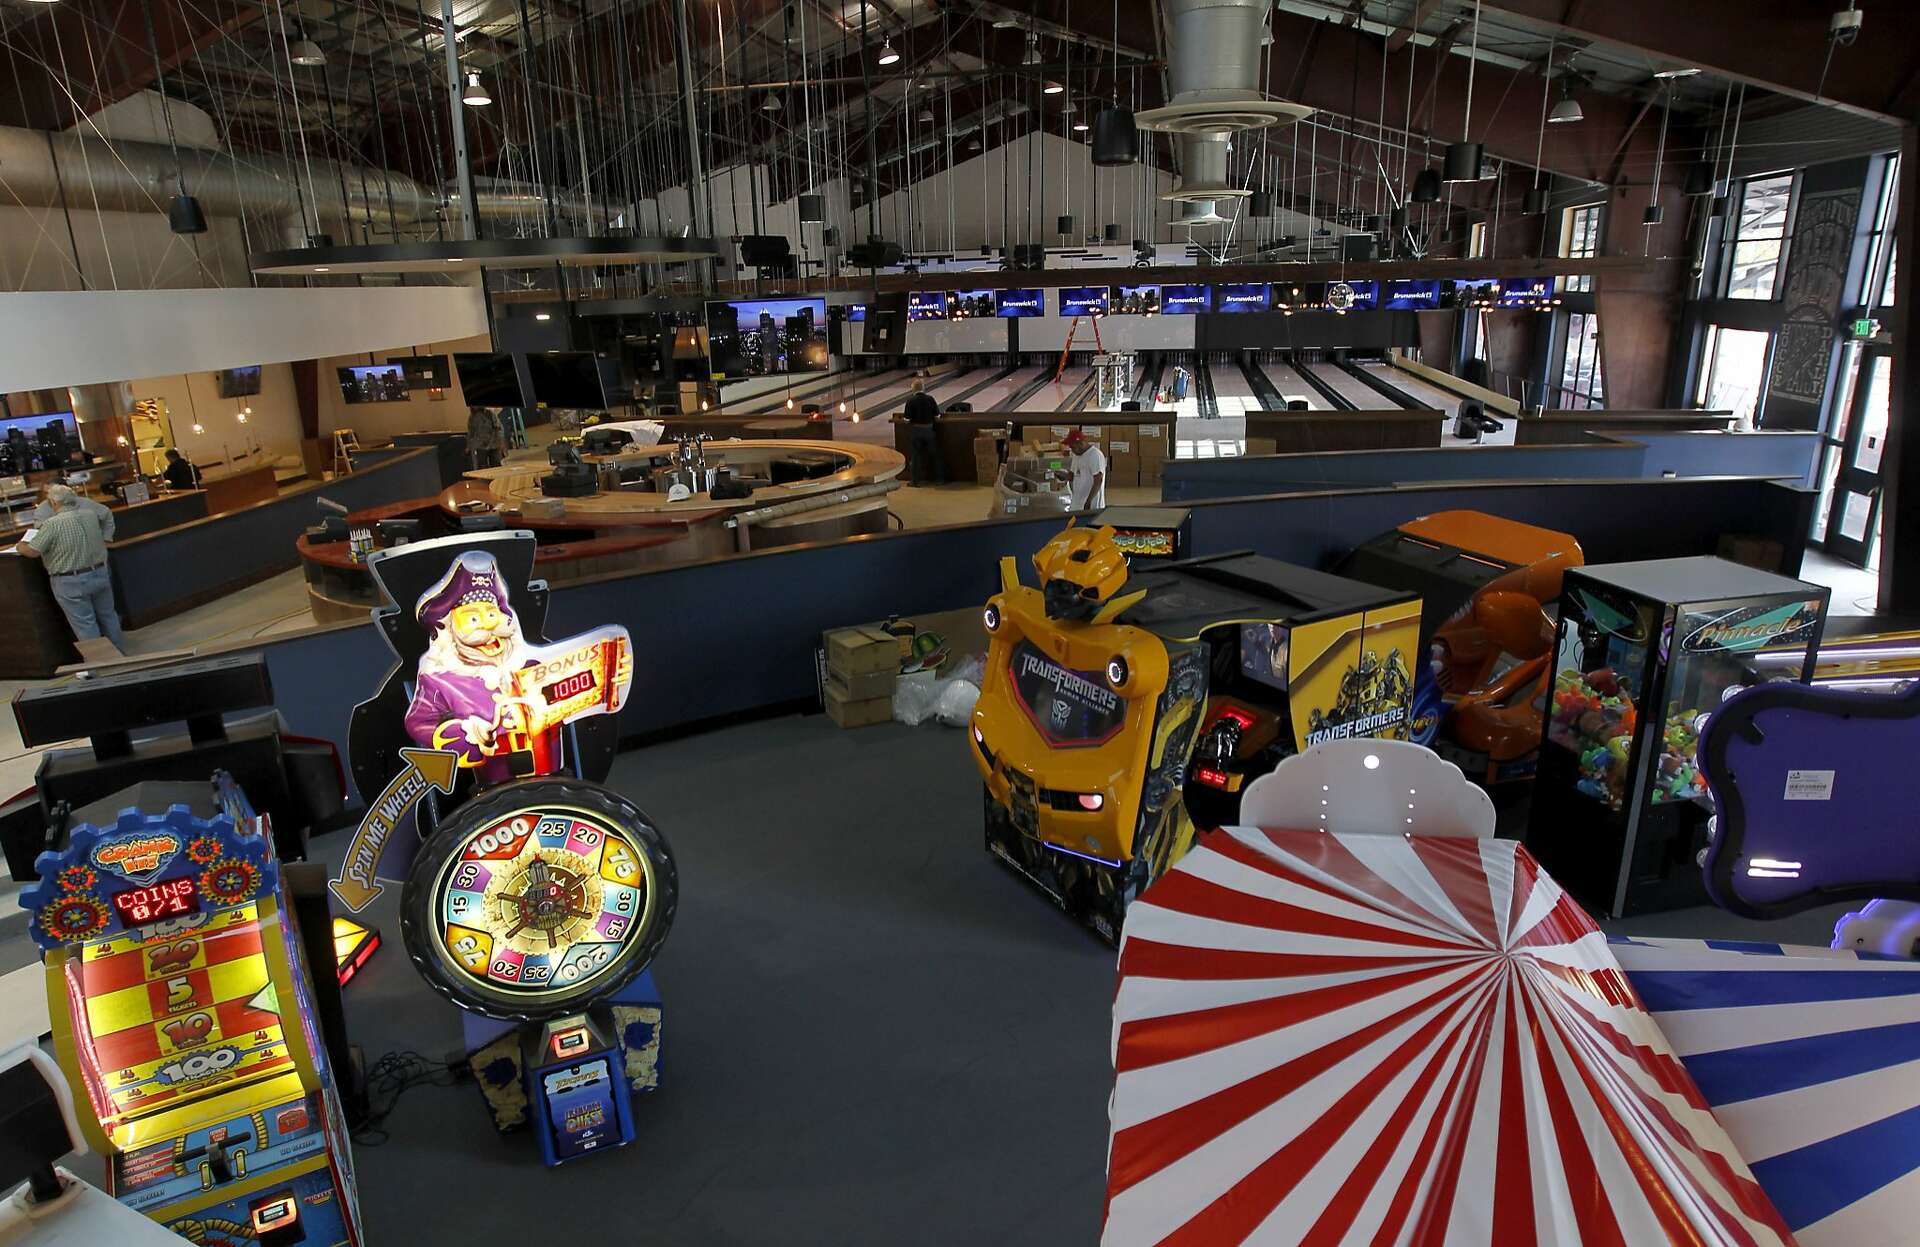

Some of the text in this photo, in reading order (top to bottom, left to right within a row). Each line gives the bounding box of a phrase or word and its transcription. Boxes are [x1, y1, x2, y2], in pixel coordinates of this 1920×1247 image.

[1696, 616, 1801, 645] Pinnacle
[533, 643, 599, 682] BONUS
[553, 673, 590, 698] 1000
[1022, 653, 1118, 711] TRANSFORMERS
[1305, 707, 1404, 747] TRANSFORMERS
[348, 767, 428, 889] SPIN ME WHEEL!
[470, 818, 530, 858] 1000
[541, 822, 565, 836] 25
[573, 827, 598, 846] 20
[96, 837, 177, 865] CRANK
[607, 847, 636, 879] 75
[457, 864, 480, 888] 30
[117, 880, 193, 909] COINS
[453, 895, 468, 915] 15
[617, 891, 632, 912] 30
[606, 919, 625, 938] 15
[149, 938, 200, 972] 20
[453, 935, 487, 967] 75
[561, 945, 608, 980] 200
[493, 961, 519, 976] 20
[525, 966, 549, 979] 25
[167, 976, 193, 1006] 5
[162, 1012, 214, 1049] 10
[162, 1049, 236, 1082] 100
